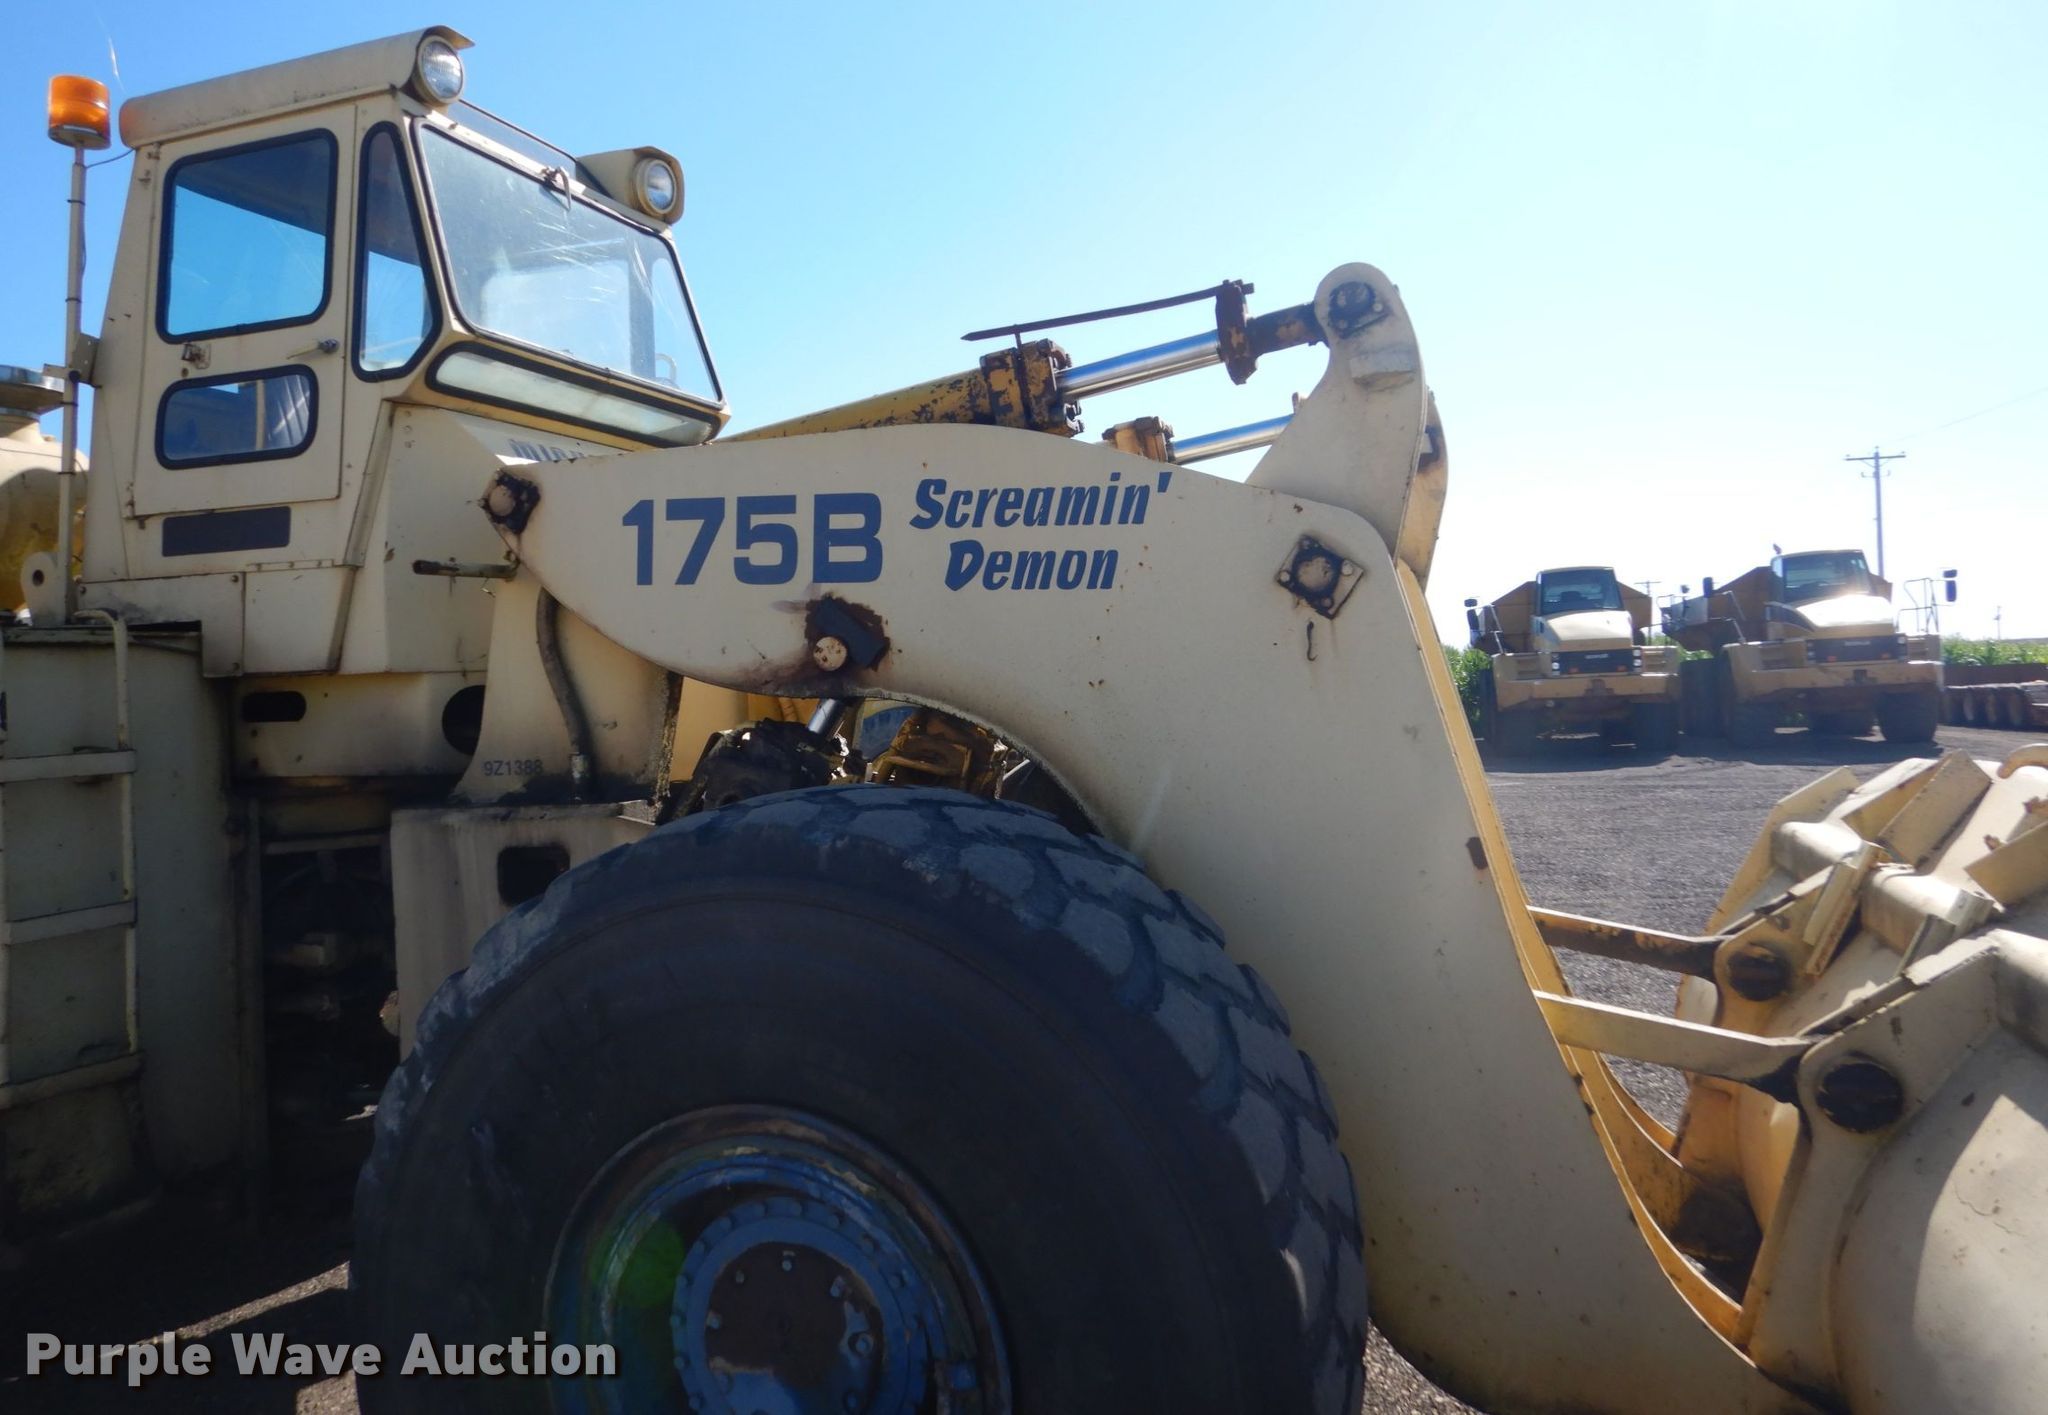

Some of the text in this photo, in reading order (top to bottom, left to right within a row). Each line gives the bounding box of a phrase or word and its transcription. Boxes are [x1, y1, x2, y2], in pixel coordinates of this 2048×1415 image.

[909, 472, 1172, 529] Screamin'
[622, 493, 884, 586] 175B
[944, 540, 1119, 591] Demon
